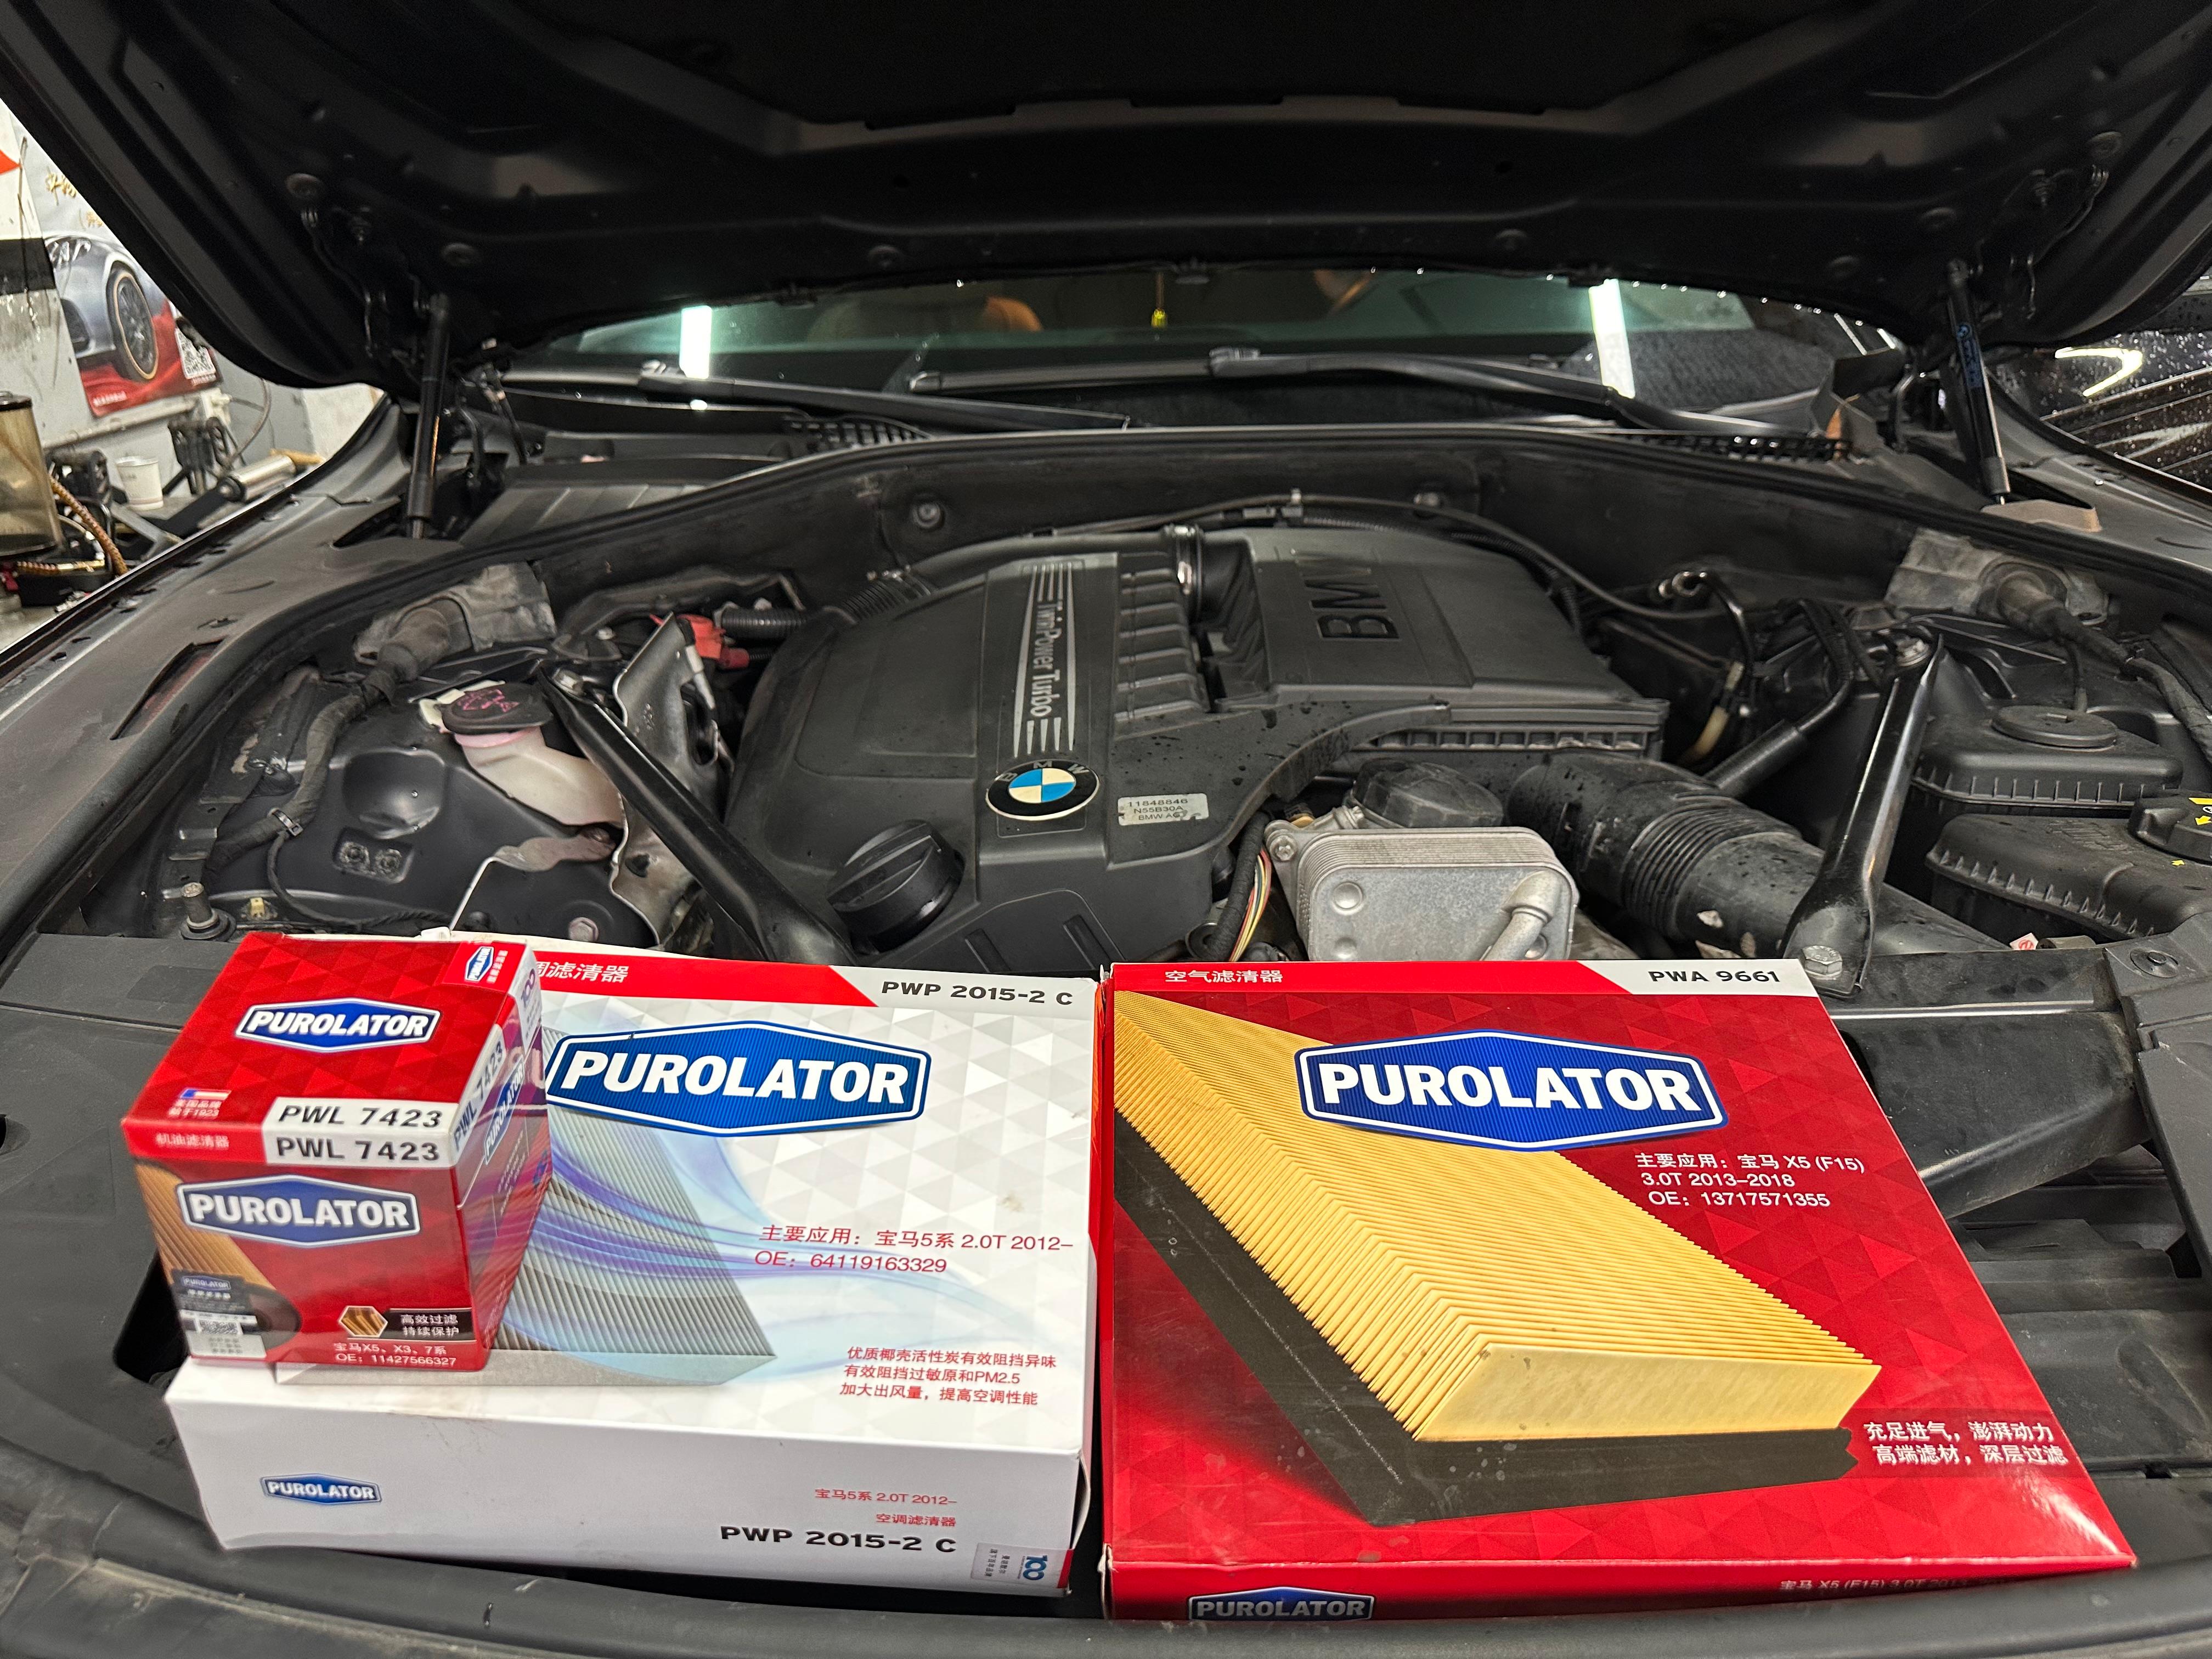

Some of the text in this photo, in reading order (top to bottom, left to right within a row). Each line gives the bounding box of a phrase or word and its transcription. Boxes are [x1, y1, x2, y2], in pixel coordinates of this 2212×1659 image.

[1030, 599, 1063, 716] TwinPower Turbo
[998, 760, 1090, 783] BMW
[1127, 798, 1188, 807] 11848846
[1133, 805, 1184, 814] N55B30A
[1165, 969, 1283, 983] 空气滤清器
[1648, 970, 1781, 983] PWA 9661
[881, 981, 1074, 1005] PWP 2015-2 C
[248, 1011, 430, 1036] PUROLATOR
[561, 1050, 909, 1104] PUROLATOR
[1318, 1063, 1702, 1111] PUROLATOR
[278, 1105, 443, 1127] PWL 7423
[276, 1136, 439, 1161] PWL 7423
[1782, 1155, 1811, 1169] X5
[1815, 1156, 1865, 1173] (F15)
[1641, 1172, 1682, 1186] 3.0T
[1701, 1192, 1831, 1207] 13717571355
[189, 1194, 408, 1227] PUROLATOR
[961, 1234, 1007, 1249] 2.0T
[810, 1254, 947, 1273] 64119163329
[400, 1314, 458, 1325] 高效过滤
[403, 1325, 460, 1338] 持续保护
[847, 1346, 1057, 1368] 优质椰壳活性炭有效阻挡异味
[844, 1364, 1021, 1384] 有效阻挡过敏原和PM2.5
[839, 1383, 1039, 1406] 加大出风量，提高空调性能
[1864, 1421, 2055, 1442] 充足进气，澎湃动力
[1873, 1444, 2068, 1465] 高端滤材，深层过滤
[268, 1481, 375, 1499] PUROLATOR
[815, 1488, 872, 1501] 宝马5系
[877, 1492, 909, 1503] 2.0T
[876, 1513, 956, 1527] 空调滤清器
[720, 1526, 957, 1553] PWP 2015-2 C
[1197, 1600, 1365, 1617] PUROLATOR
